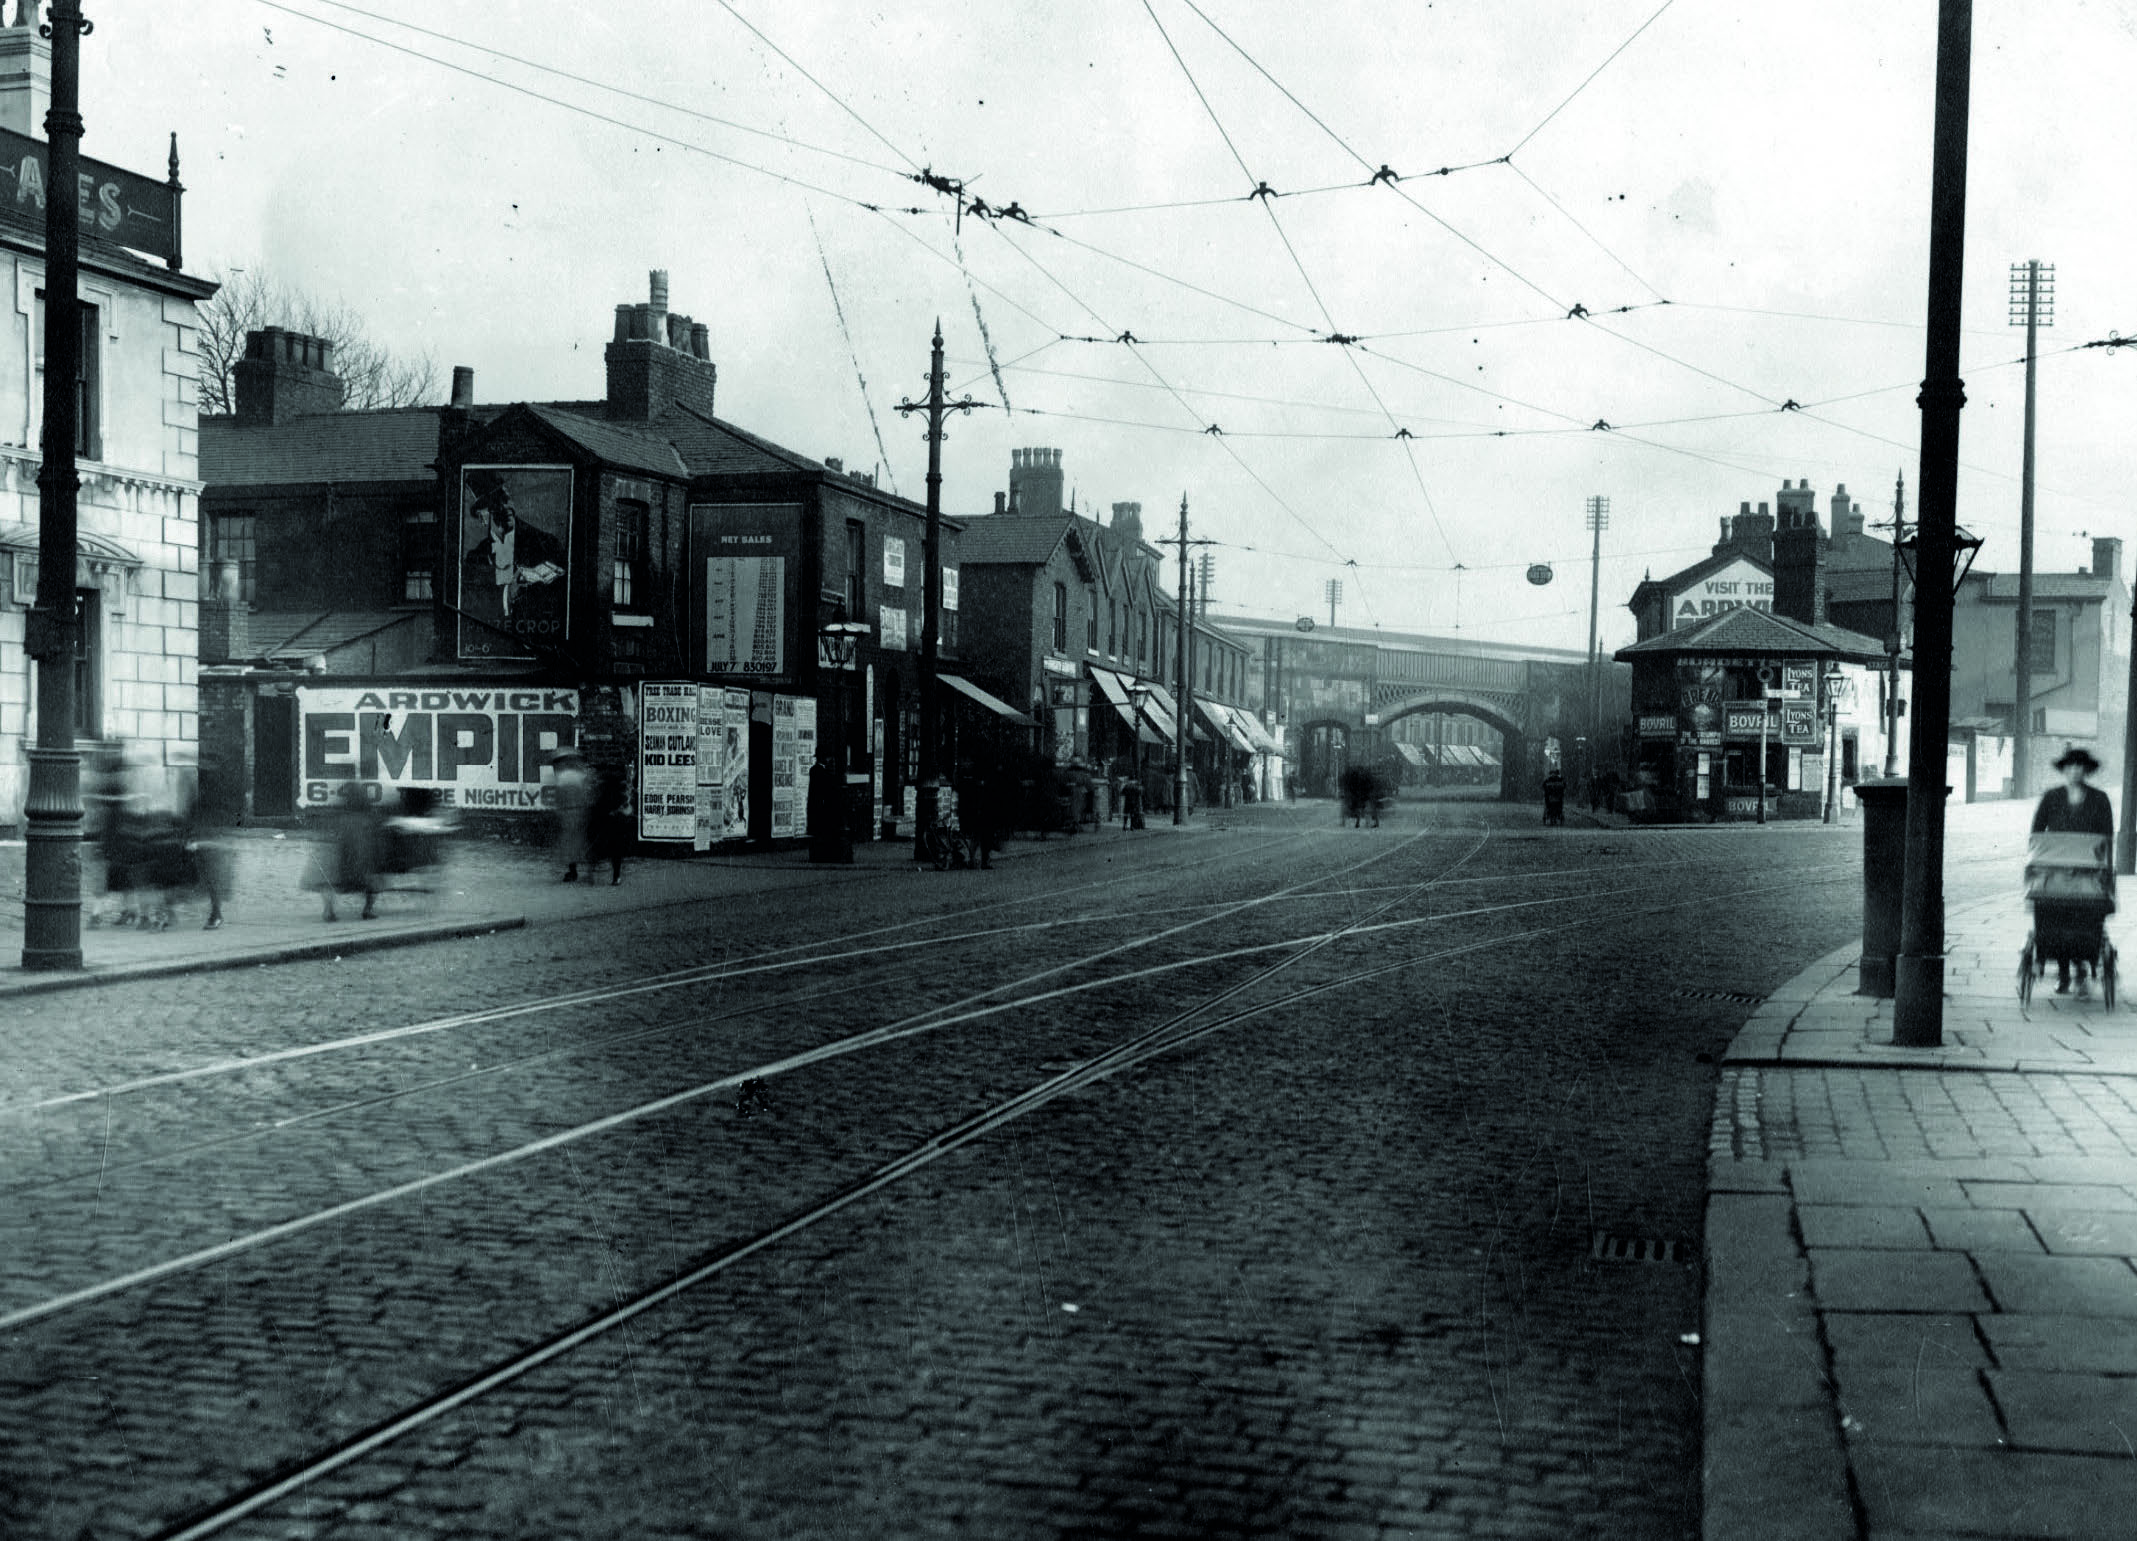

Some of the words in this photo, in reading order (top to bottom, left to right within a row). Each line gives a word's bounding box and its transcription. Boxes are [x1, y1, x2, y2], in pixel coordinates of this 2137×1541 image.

[16, 155, 122, 232] AES
[721, 535, 739, 544] NET
[741, 535, 773, 544] SALES
[1705, 582, 1738, 595] VISIT
[1746, 582, 1774, 595] THE
[1677, 599, 1774, 617] ARDWI
[515, 619, 561, 634] CROP
[711, 661, 728, 672] JULY
[729, 661, 737, 672] 7
[355, 692, 577, 711] ARDWICK
[646, 707, 696, 722] BOXING
[1640, 717, 1675, 730] BOVRIL
[1788, 724, 1809, 734] TEA
[700, 726, 722, 736] LOVE
[645, 754, 665, 766] KID
[396, 787, 455, 804] TCE
[465, 788, 541, 806] NIGHTLY
[1729, 801, 1774, 812] BOVRL
